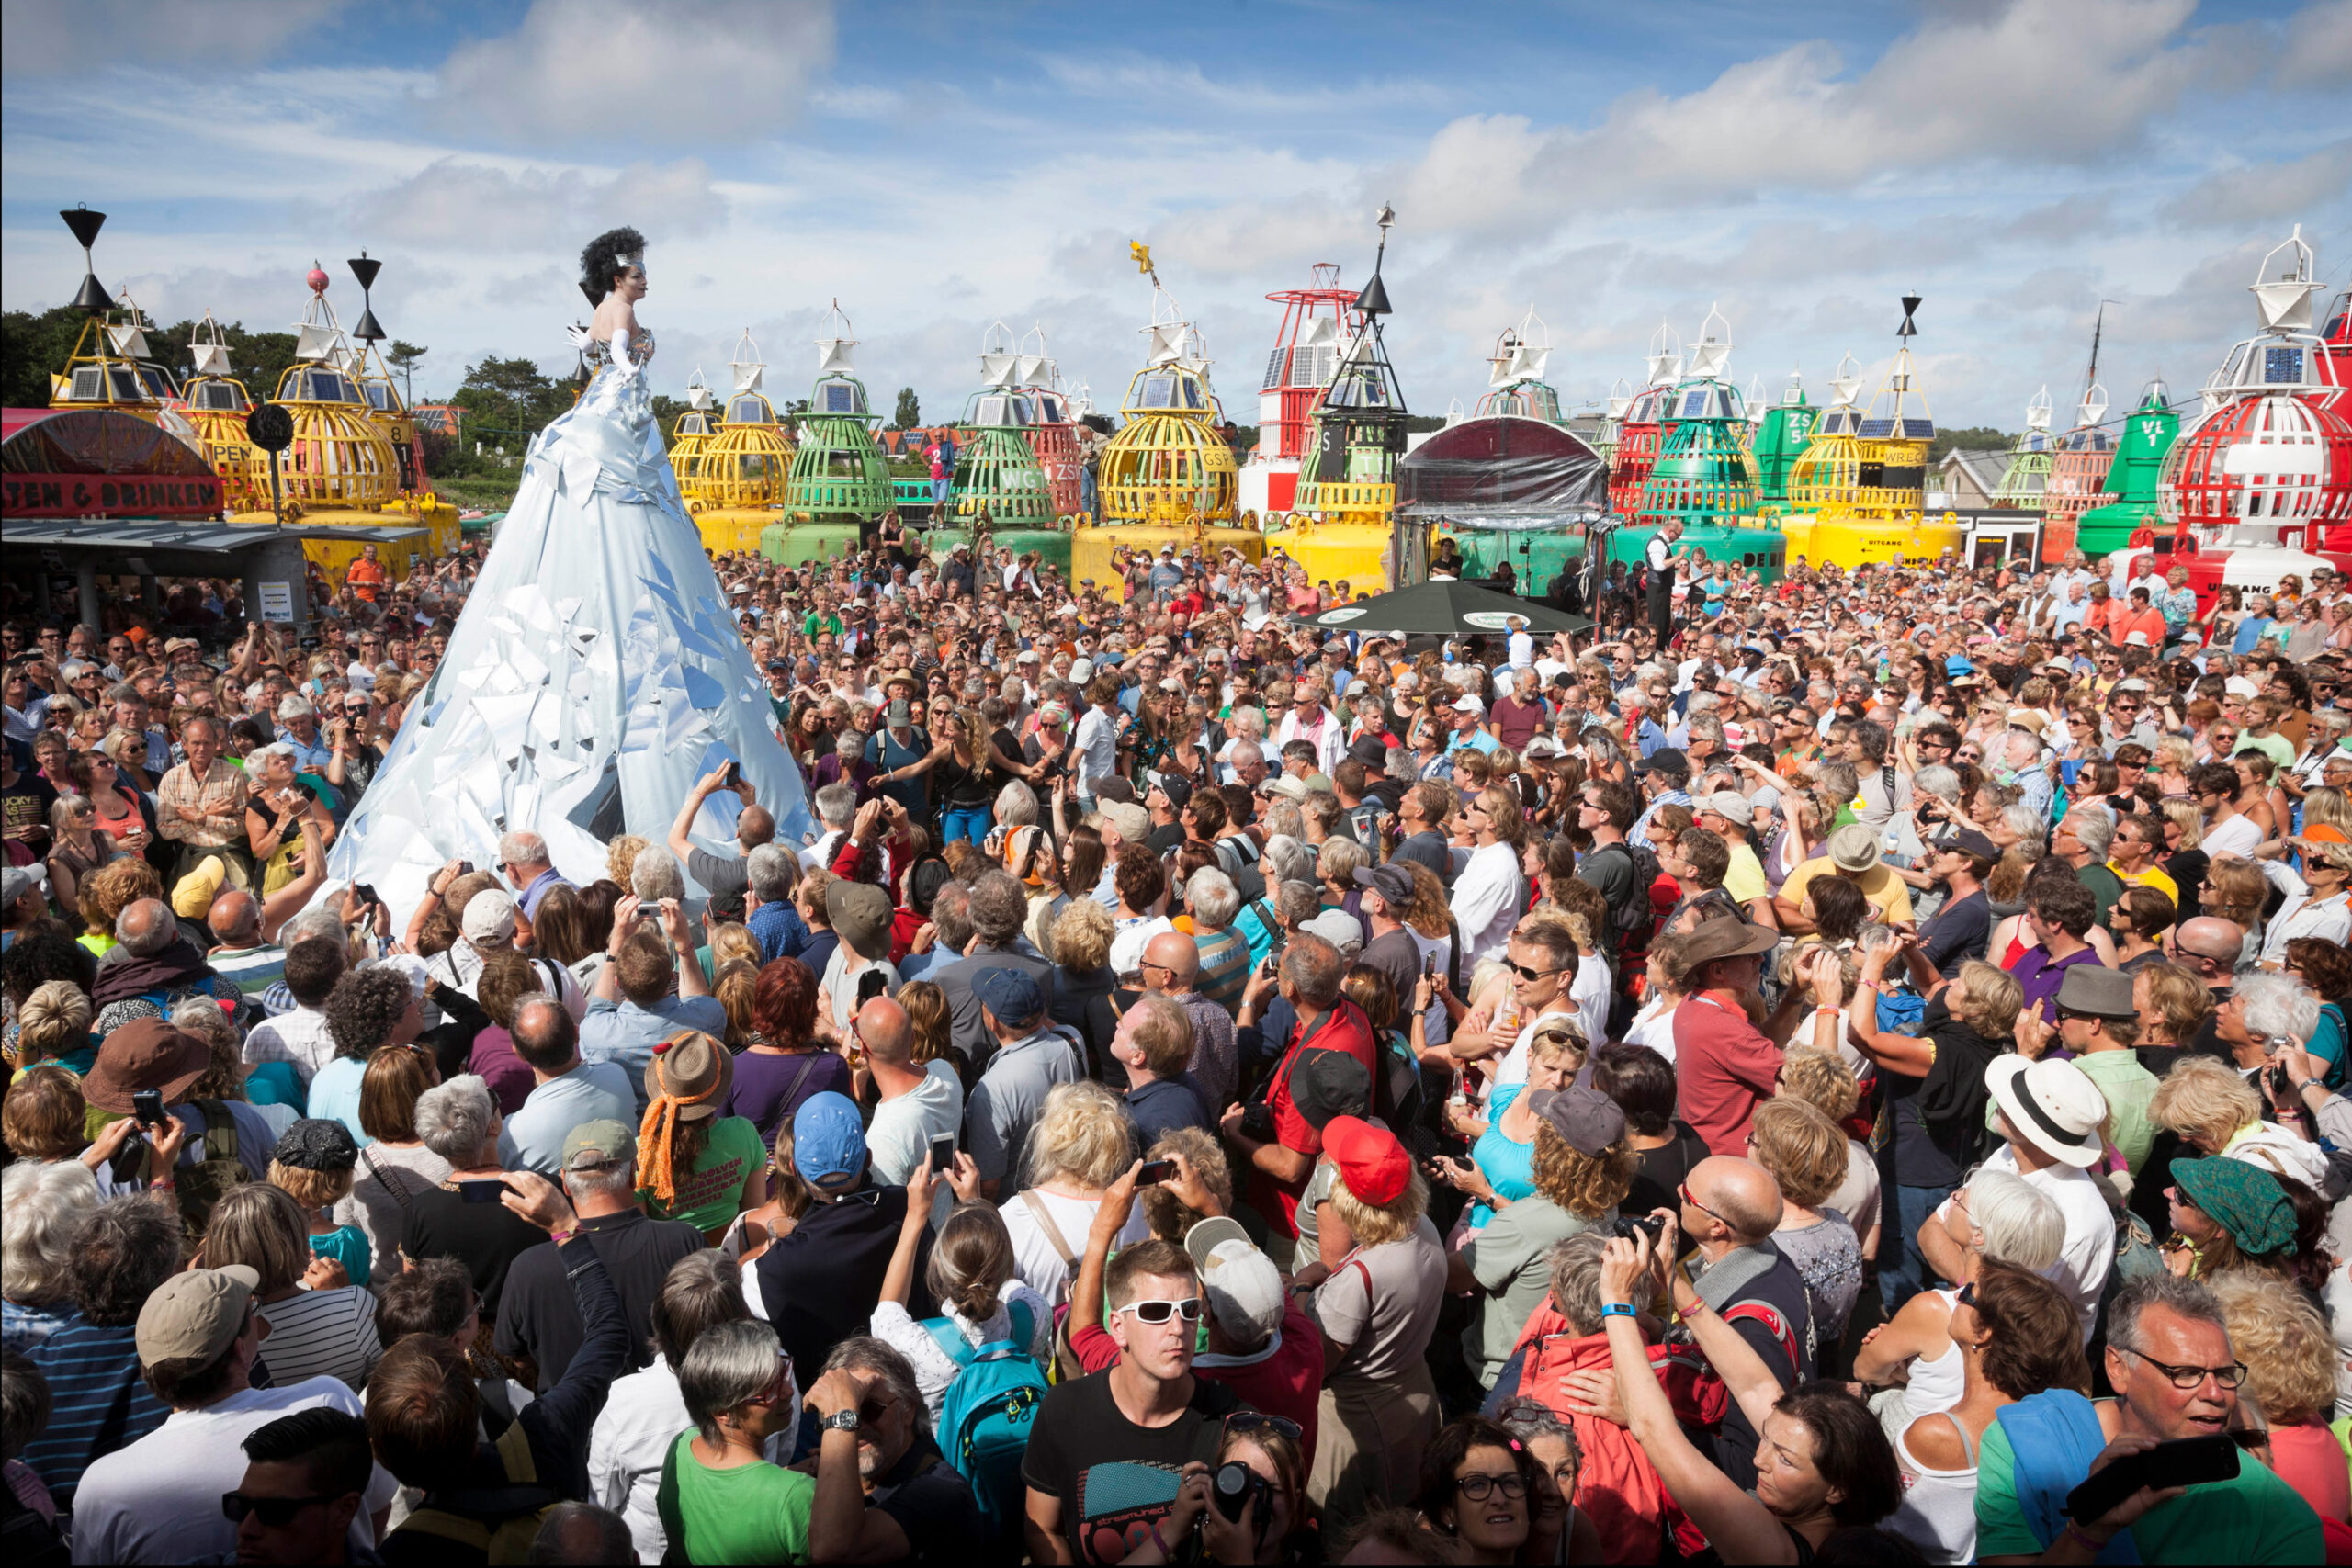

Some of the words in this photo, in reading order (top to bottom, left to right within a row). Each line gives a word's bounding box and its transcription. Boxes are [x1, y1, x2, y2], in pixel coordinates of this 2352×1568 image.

[1789, 413, 1811, 428] ZS
[2142, 420, 2165, 434] VL
[391, 426, 401, 442] 8
[1322, 431, 1331, 452] S
[2148, 434, 2156, 447] 1
[401, 446, 407, 461] 1
[2, 482, 62, 507] TEN
[74, 482, 91, 506] &
[101, 482, 216, 507] DRINKEN
